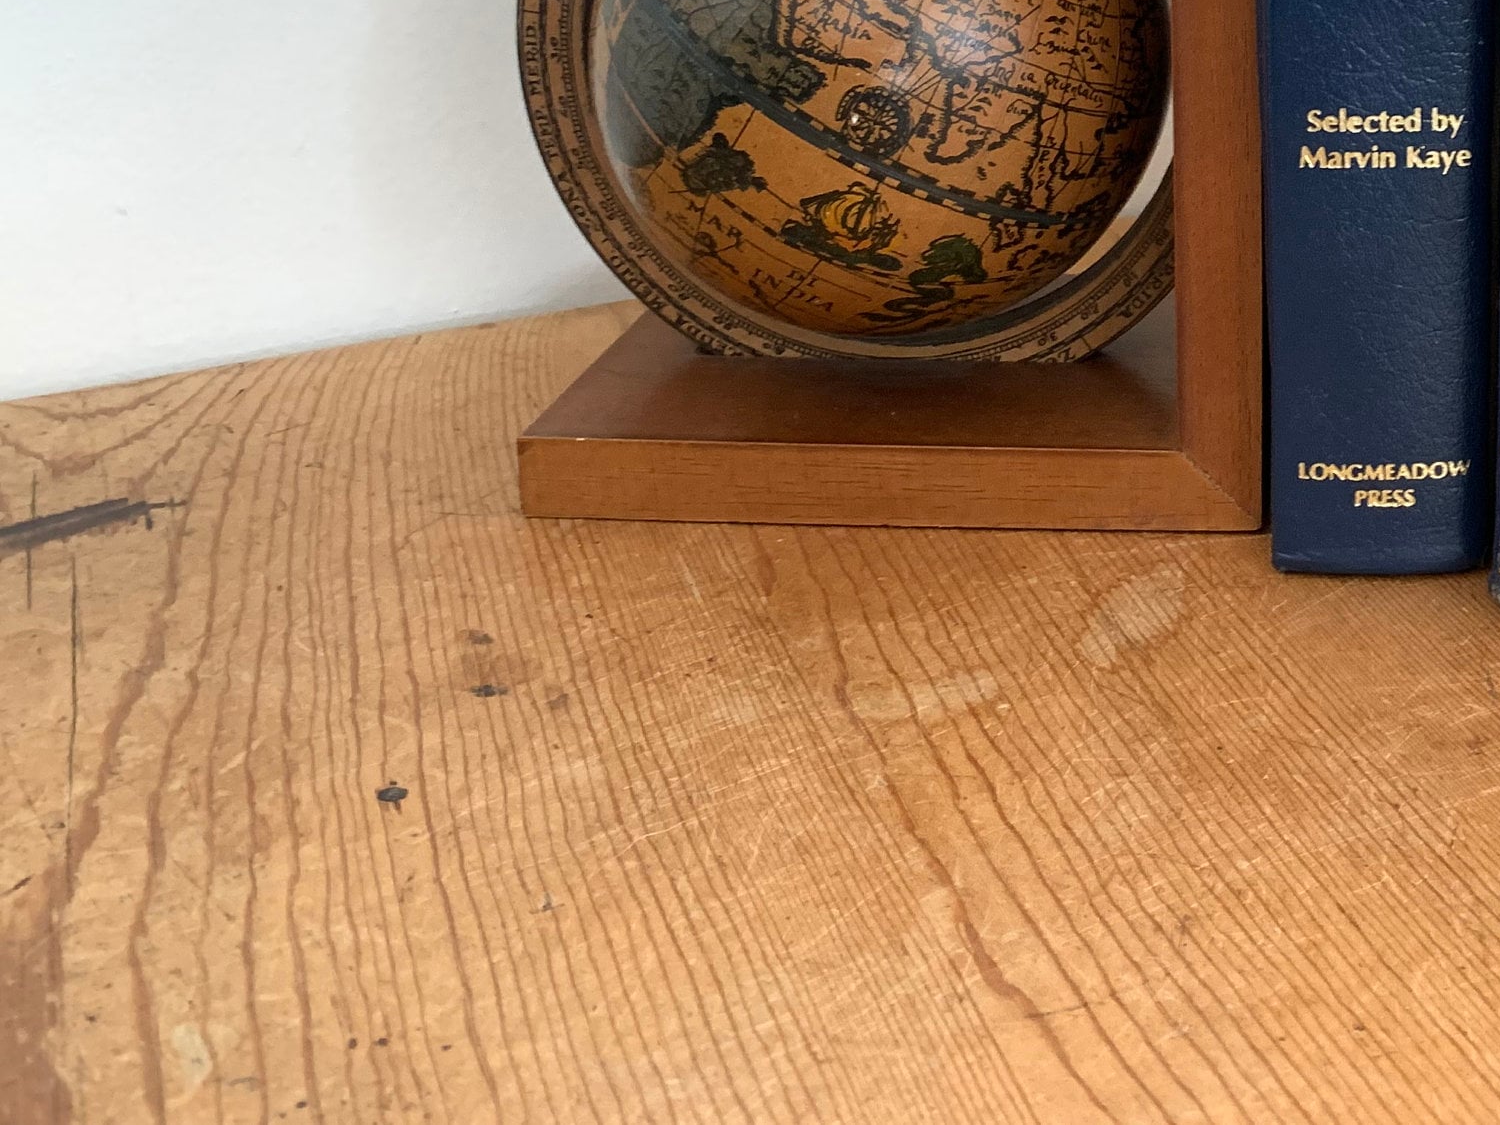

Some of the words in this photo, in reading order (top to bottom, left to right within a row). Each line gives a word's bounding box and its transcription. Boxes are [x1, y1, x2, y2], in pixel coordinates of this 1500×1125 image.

[1306, 108, 1422, 133] Selected
[1431, 108, 1464, 138] by
[1299, 146, 1396, 168] Marvin
[1406, 145, 1472, 174] Kaye
[1298, 460, 1471, 480] LONGMEADOW
[1354, 490, 1416, 507] PRESS
